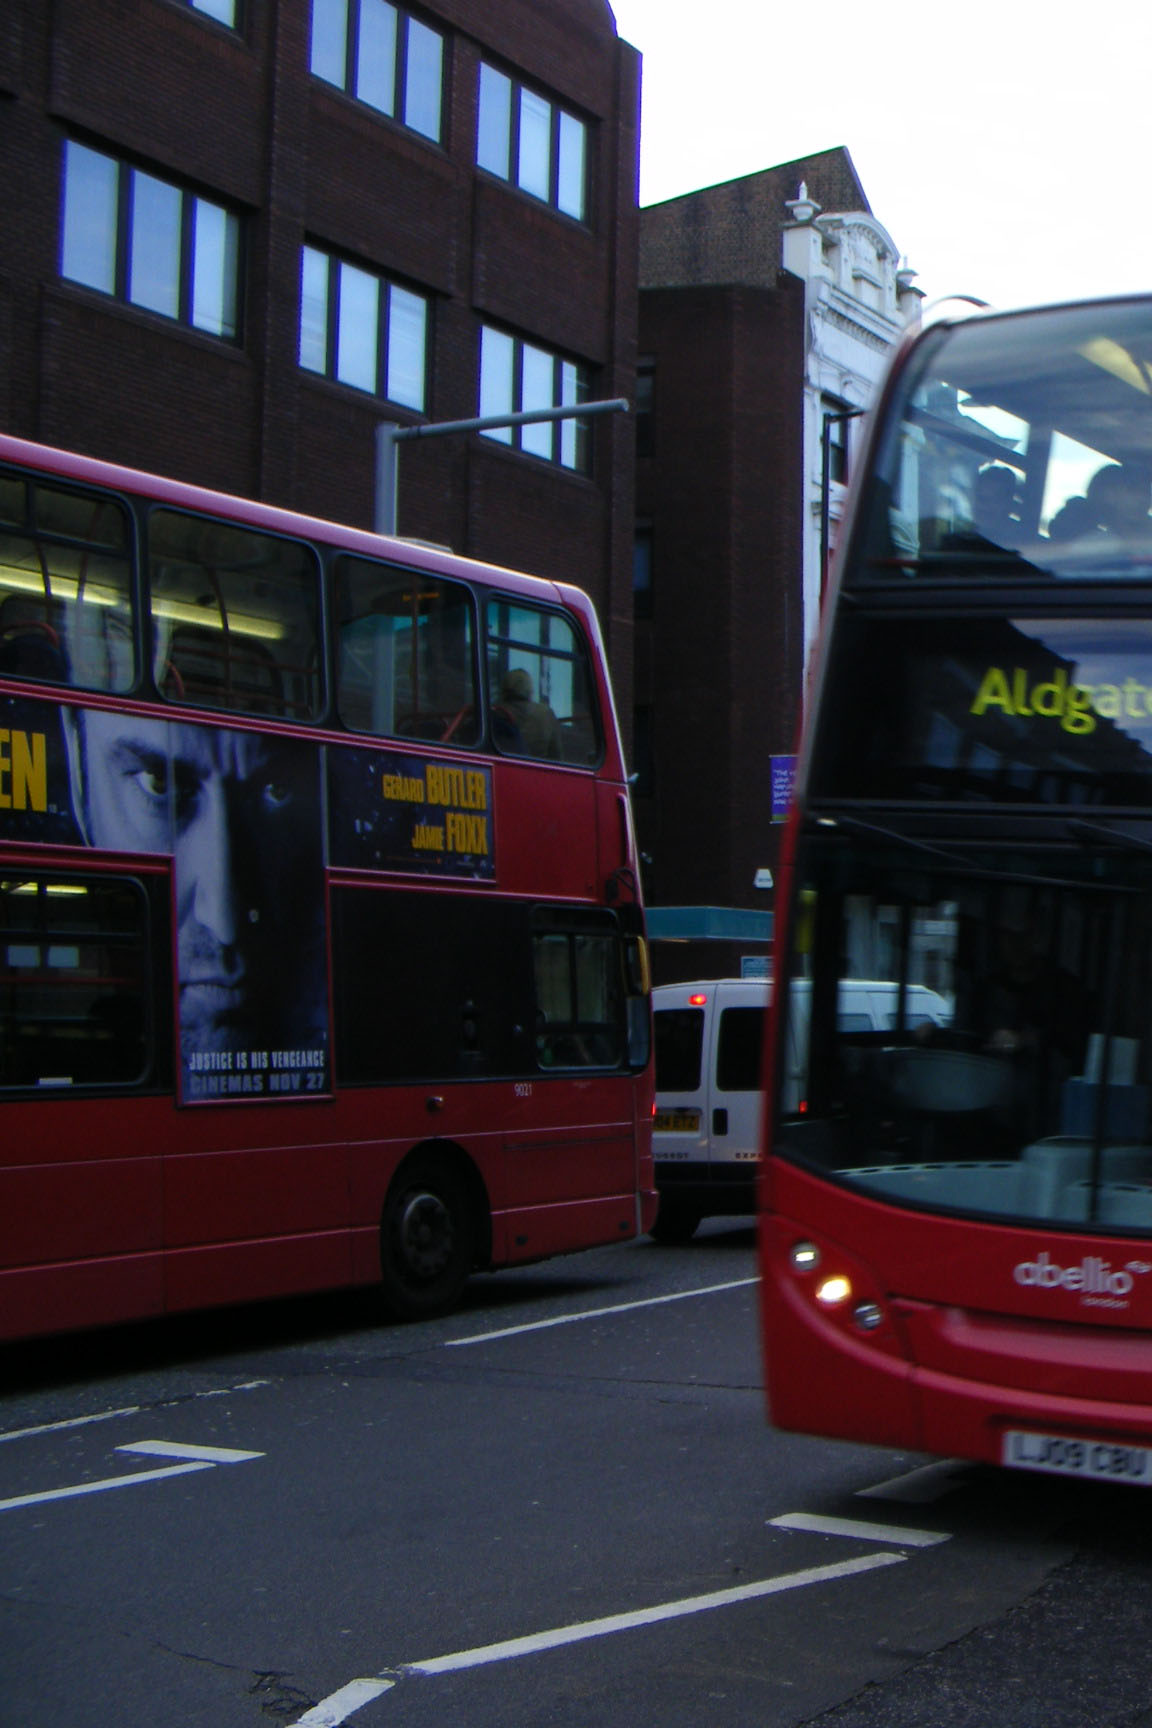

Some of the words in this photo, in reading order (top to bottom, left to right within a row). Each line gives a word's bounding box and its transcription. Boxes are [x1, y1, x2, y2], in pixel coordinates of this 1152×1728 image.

[382, 774, 425, 803] GERARD
[425, 764, 487, 810] BUTLER
[412, 824, 445, 851] JAMIE
[445, 812, 488, 855] FOXX
[189, 1051, 233, 1071] JUSTICE
[236, 1051, 247, 1069] IS
[250, 1051, 269, 1069] HIS
[271, 1049, 325, 1068] VENGEANCE
[189, 1074, 264, 1095] CINEMAS
[268, 1072, 301, 1092] NOV
[305, 1072, 325, 1090] 27
[513, 1082, 533, 1096] 9021
[1012, 1250, 1134, 1295] abellio
[1014, 1434, 1085, 1467] LJ09
